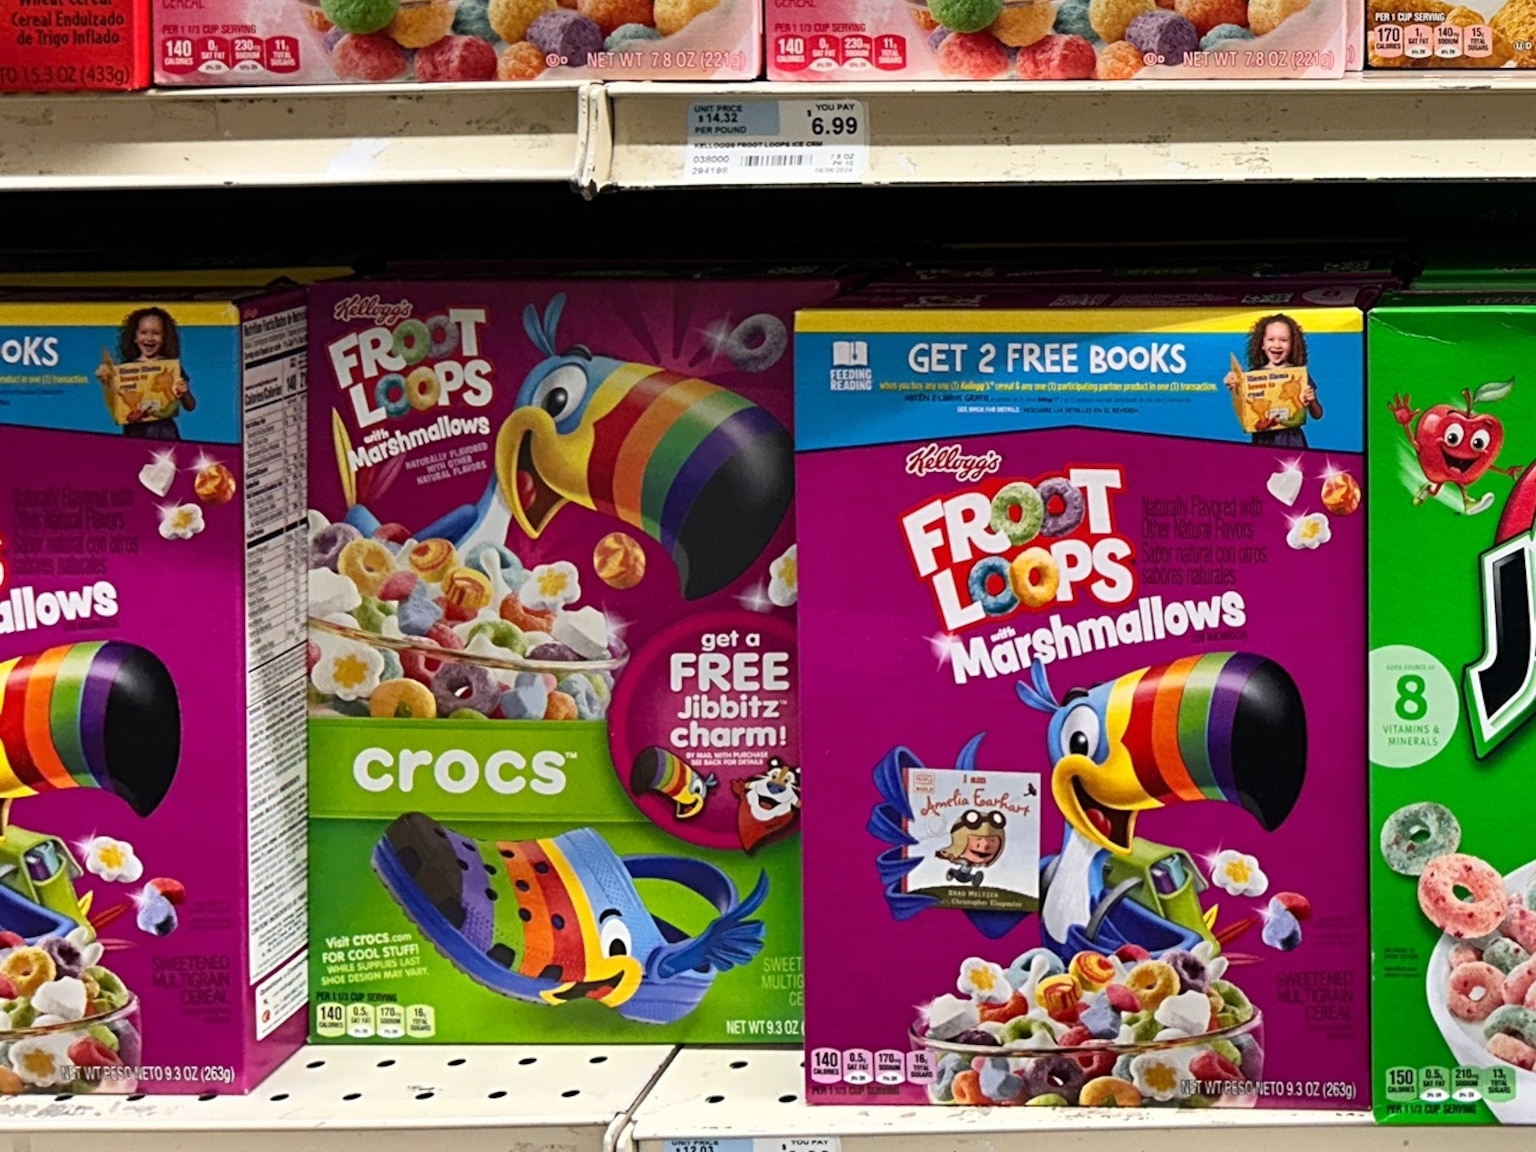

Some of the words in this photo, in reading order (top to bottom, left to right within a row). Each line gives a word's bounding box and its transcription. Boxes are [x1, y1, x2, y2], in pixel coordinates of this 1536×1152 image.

[587, 52, 614, 69] NET
[618, 52, 642, 69] WT
[650, 52, 671, 69] 7.8
[674, 52, 696, 69] OZ
[699, 50, 746, 71] (221g)
[334, 294, 413, 324] Kellogg's
[328, 310, 484, 389] FROOT
[909, 343, 967, 373] GET
[979, 343, 996, 372] 2
[1007, 343, 1078, 373] FREE
[1089, 343, 1186, 373] BOOKS
[830, 369, 872, 379] FEEDING
[830, 380, 872, 391] READING
[348, 360, 492, 430] LOOPS
[346, 417, 491, 472] Marshmallows
[907, 444, 1001, 480] Kellogg's
[902, 468, 1122, 578] FROOT
[933, 539, 1132, 631] LOOPS
[702, 631, 738, 653] get
[950, 592, 1246, 683] Marshmallows
[670, 654, 789, 691] FREE
[676, 694, 779, 719] Jibbitz
[1395, 676, 1428, 720] 8
[669, 721, 786, 748] charm!
[352, 746, 568, 795] crocs
[920, 789, 970, 816] Amelia
[974, 788, 1031, 816] Earhart
